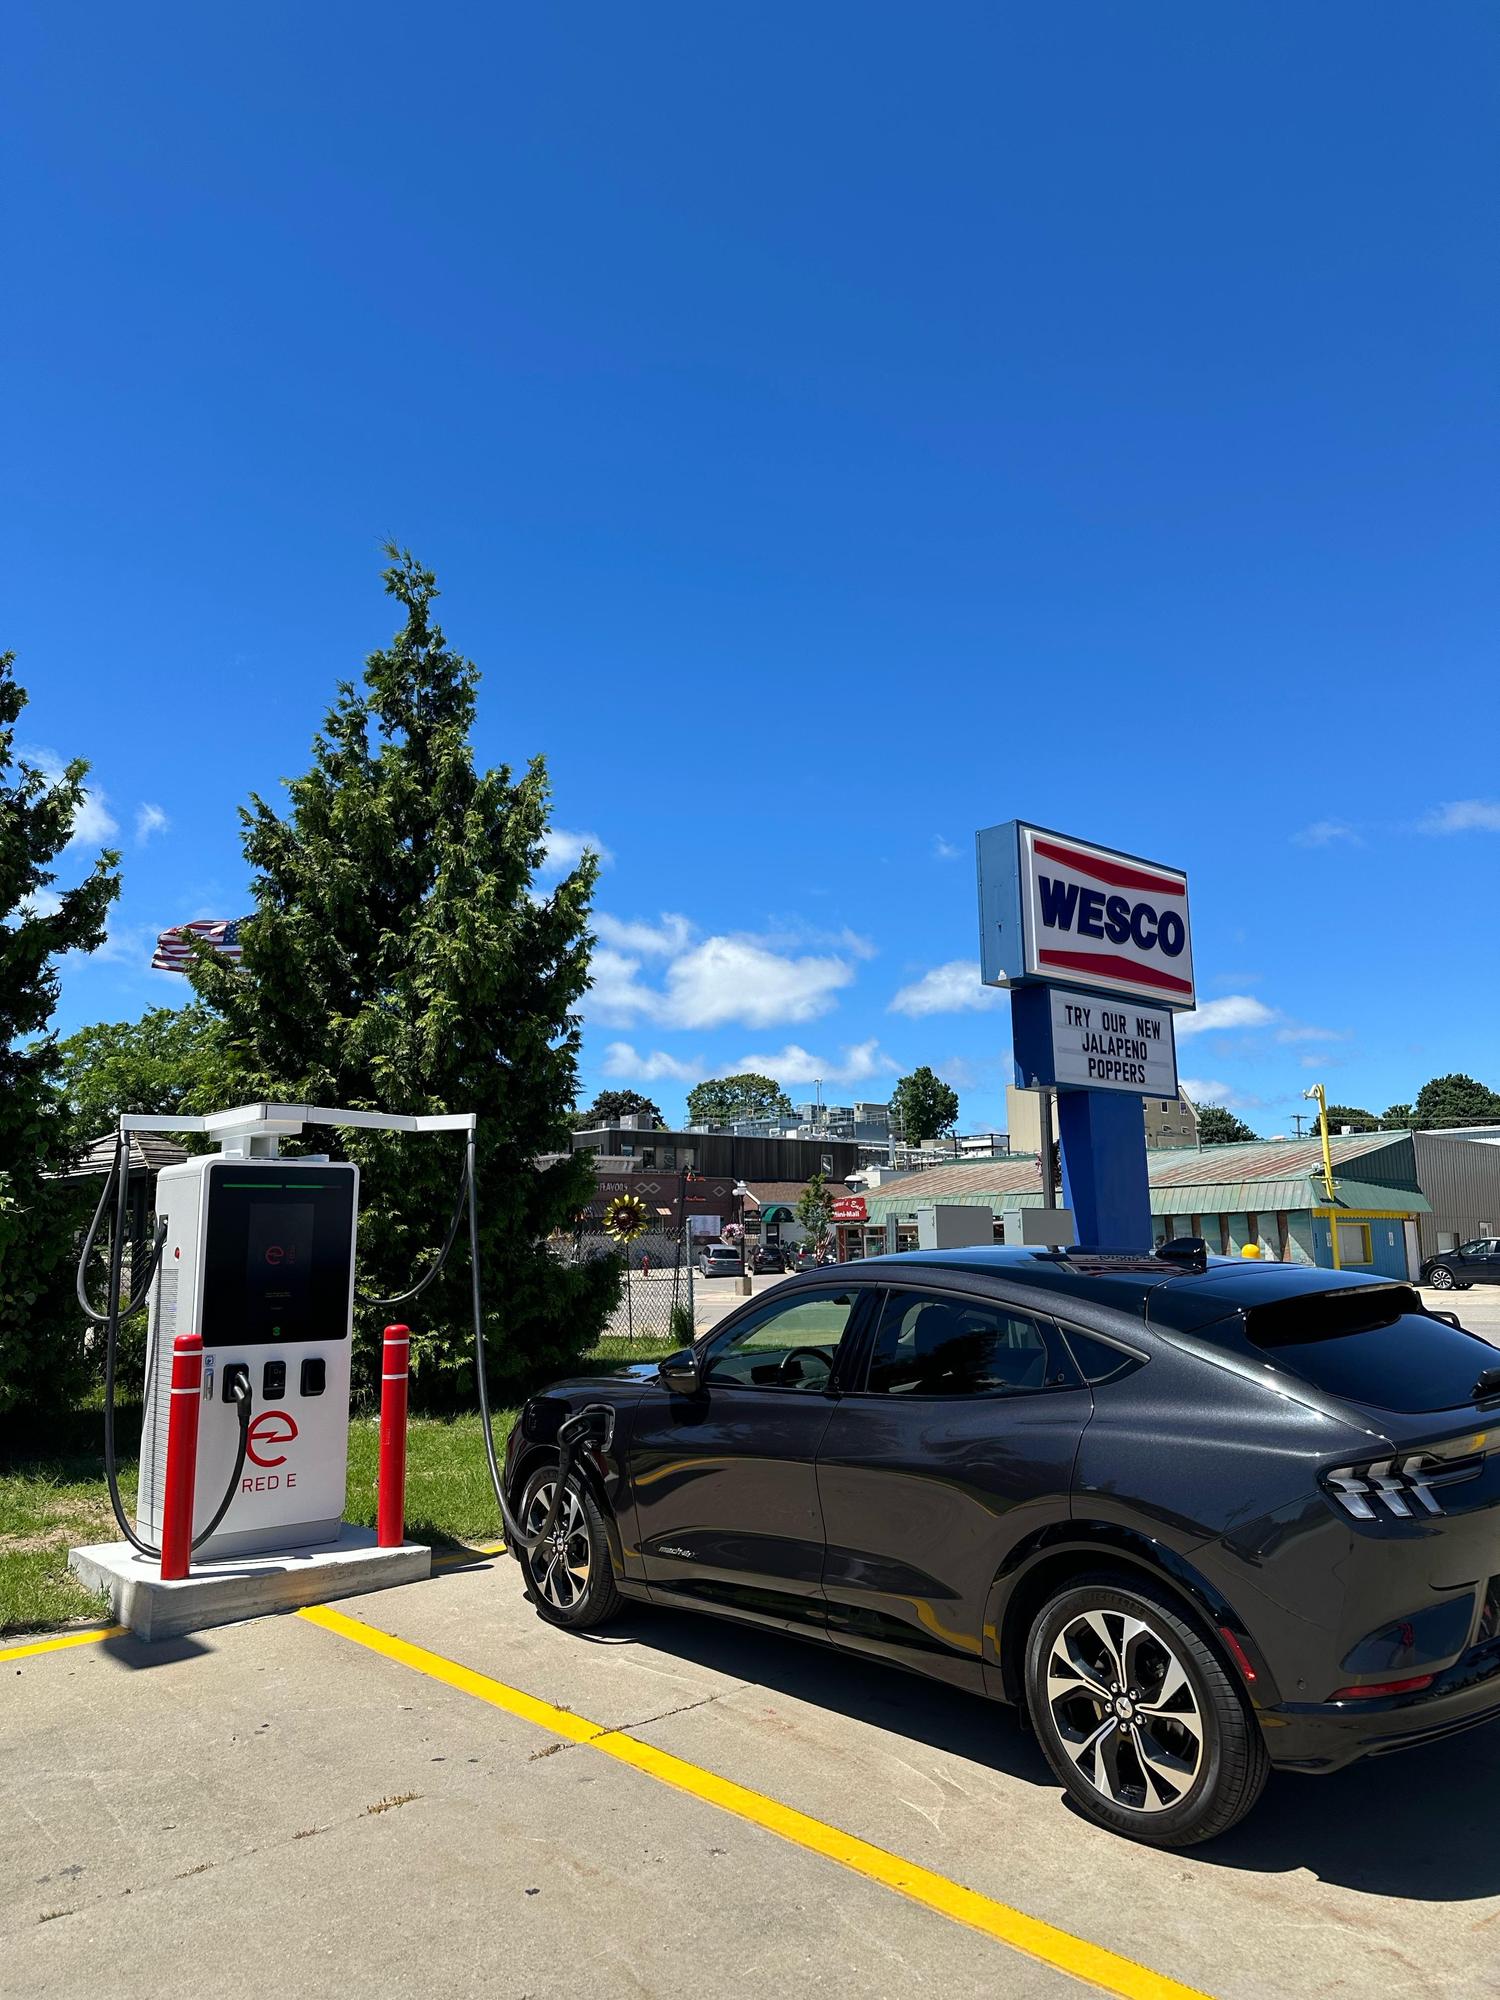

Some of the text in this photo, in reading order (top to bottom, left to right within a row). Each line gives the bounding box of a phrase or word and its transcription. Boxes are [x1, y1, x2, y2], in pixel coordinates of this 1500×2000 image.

[1038, 875, 1185, 957] WESCO
[1065, 1005, 1160, 1040] TRY OUR NEW
[1082, 1032, 1147, 1061] JALAPENO
[1088, 1058, 1146, 1084] POPPERS
[242, 1473, 297, 1494] RED E
